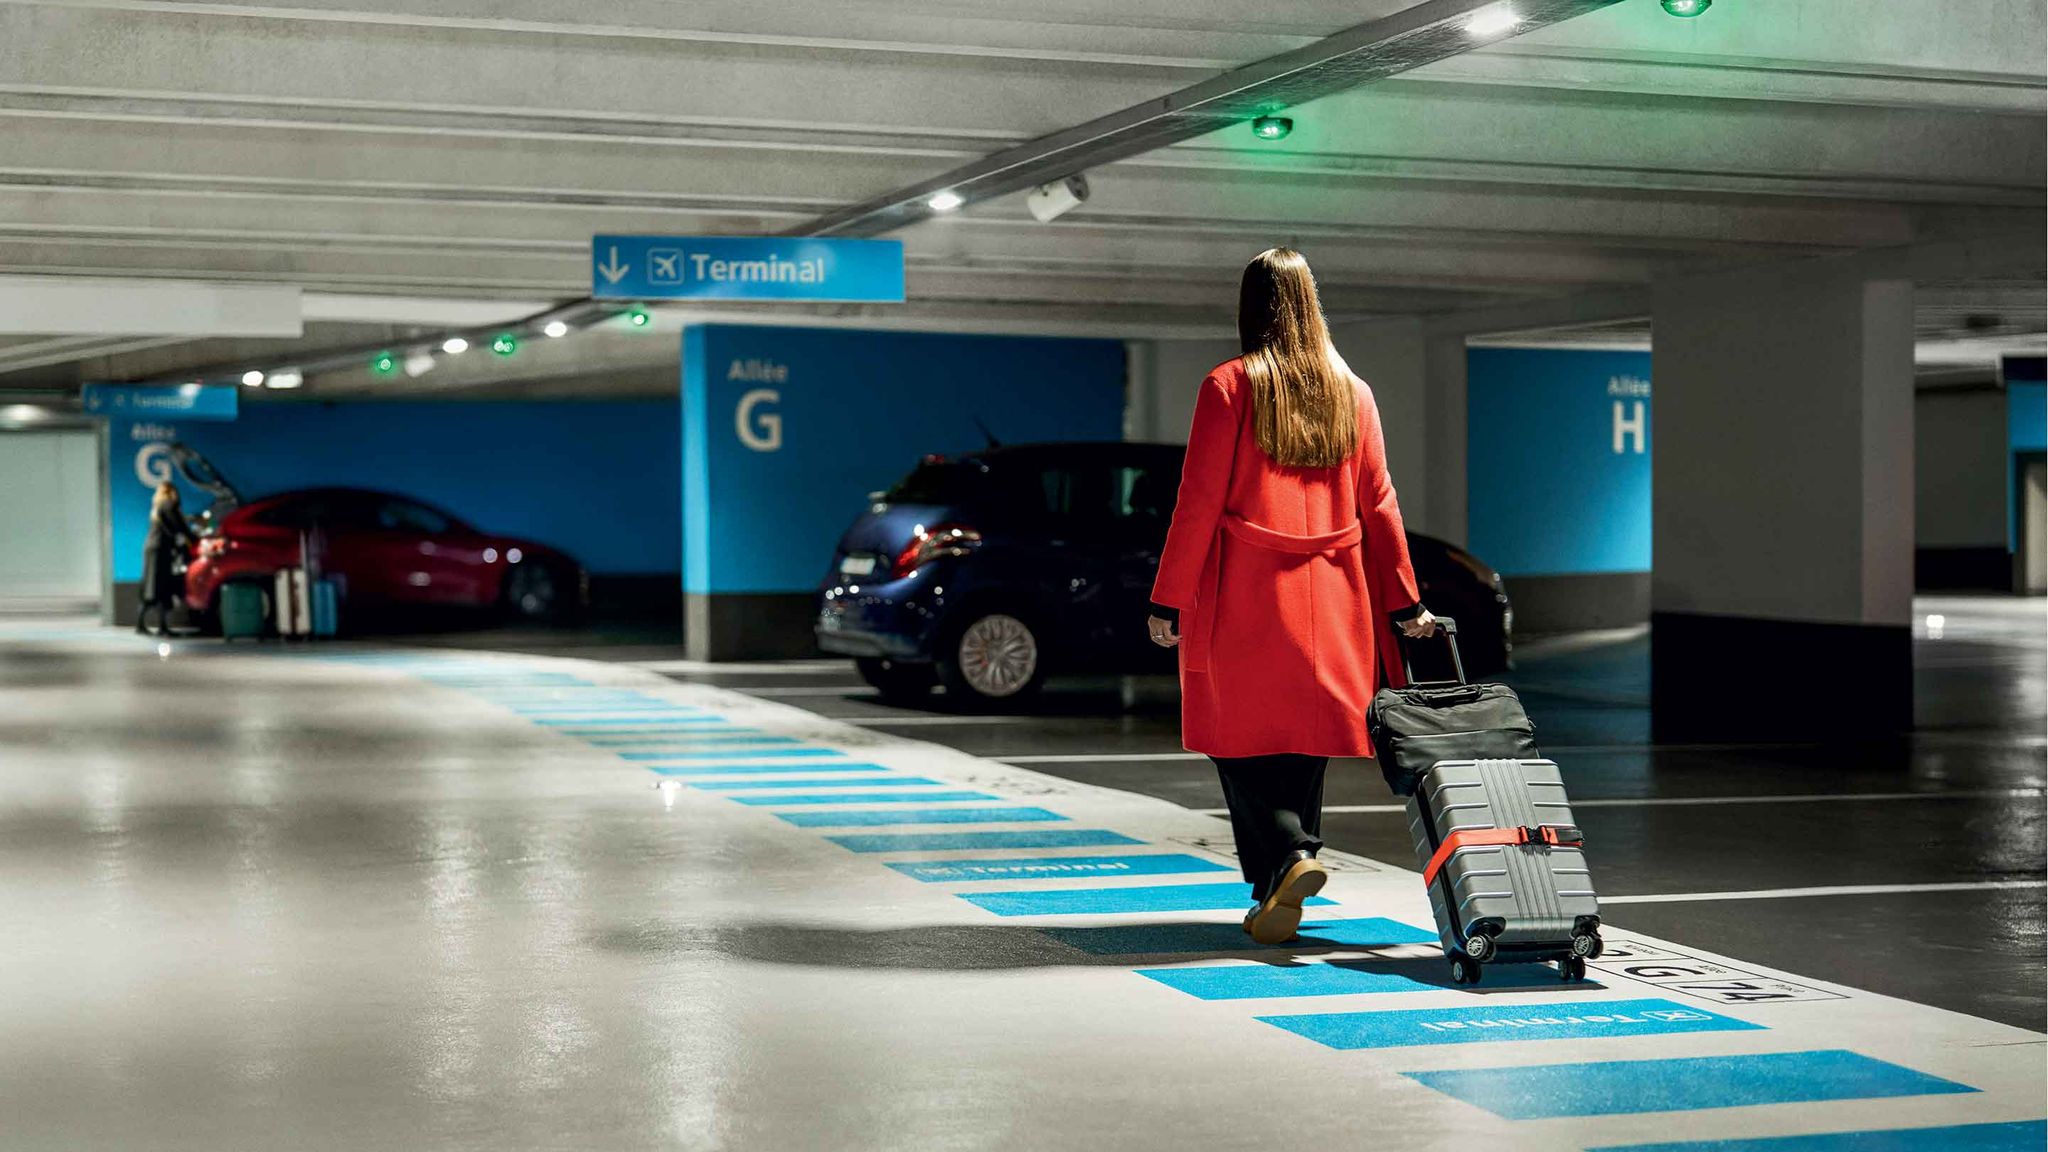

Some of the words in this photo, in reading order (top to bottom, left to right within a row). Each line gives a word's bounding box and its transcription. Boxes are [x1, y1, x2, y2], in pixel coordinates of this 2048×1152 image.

[691, 254, 824, 283] Terminal
[728, 359, 788, 382] Allée
[735, 389, 783, 451] G
[1613, 400, 1645, 454] H
[135, 442, 173, 489] G
[965, 862, 1130, 873] Terminal
[1624, 965, 1705, 978] G
[1679, 982, 1795, 1001] 74
[1420, 1014, 1647, 1031] Terminal
